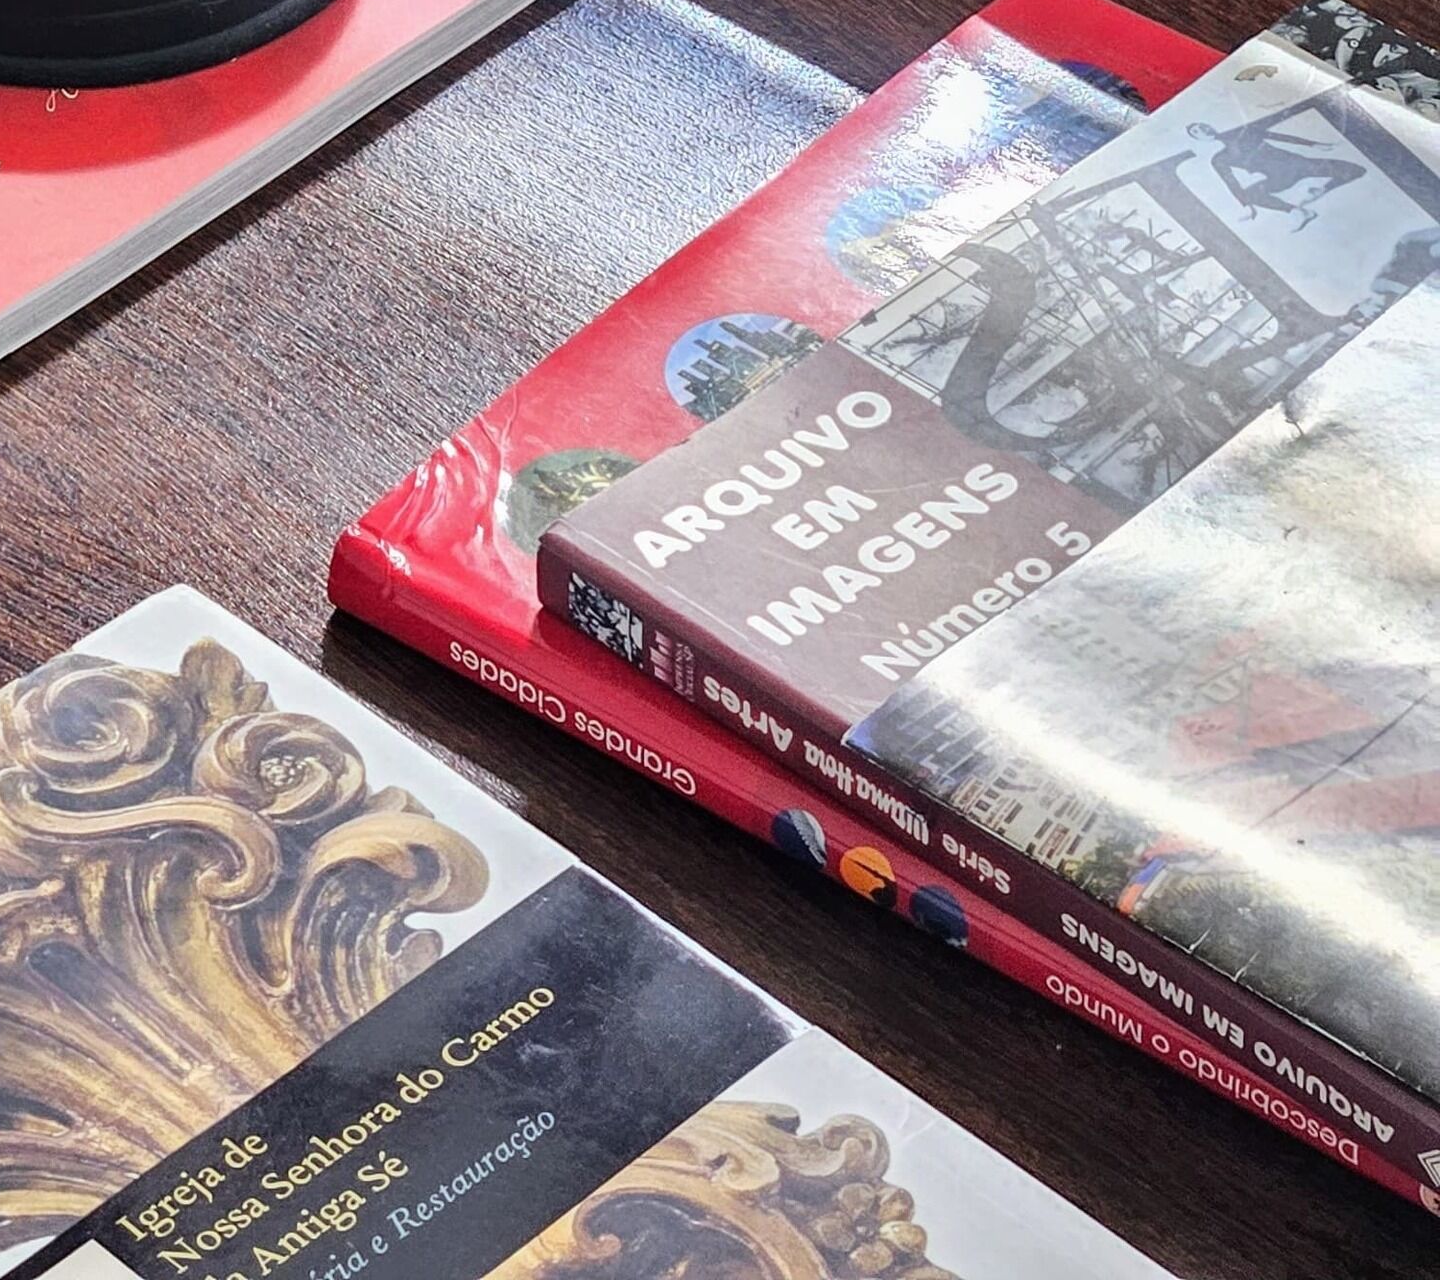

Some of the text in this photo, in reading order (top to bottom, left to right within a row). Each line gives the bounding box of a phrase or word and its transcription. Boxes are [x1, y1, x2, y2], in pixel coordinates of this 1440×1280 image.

[631, 389, 894, 571] ARQUIVO
[746, 463, 1020, 645] IMAGENS
[770, 482, 879, 552] EM
[860, 520, 1094, 683] Número 5
[448, 639, 698, 799] Grandes Cidades
[702, 673, 794, 752] Artes
[941, 832, 1012, 896] Série
[1045, 973, 1362, 1167] Descobrindo o Mundo
[1060, 911, 1397, 1145] ARQUIVO EM IMAGENS
[115, 1130, 269, 1243] Igreja de
[155, 984, 557, 1276] Nossa Senhora do Carmo
[371, 1233, 389, 1255] e
[386, 1108, 557, 1241] Restauração
[250, 1149, 410, 1277] Antiga Sé
